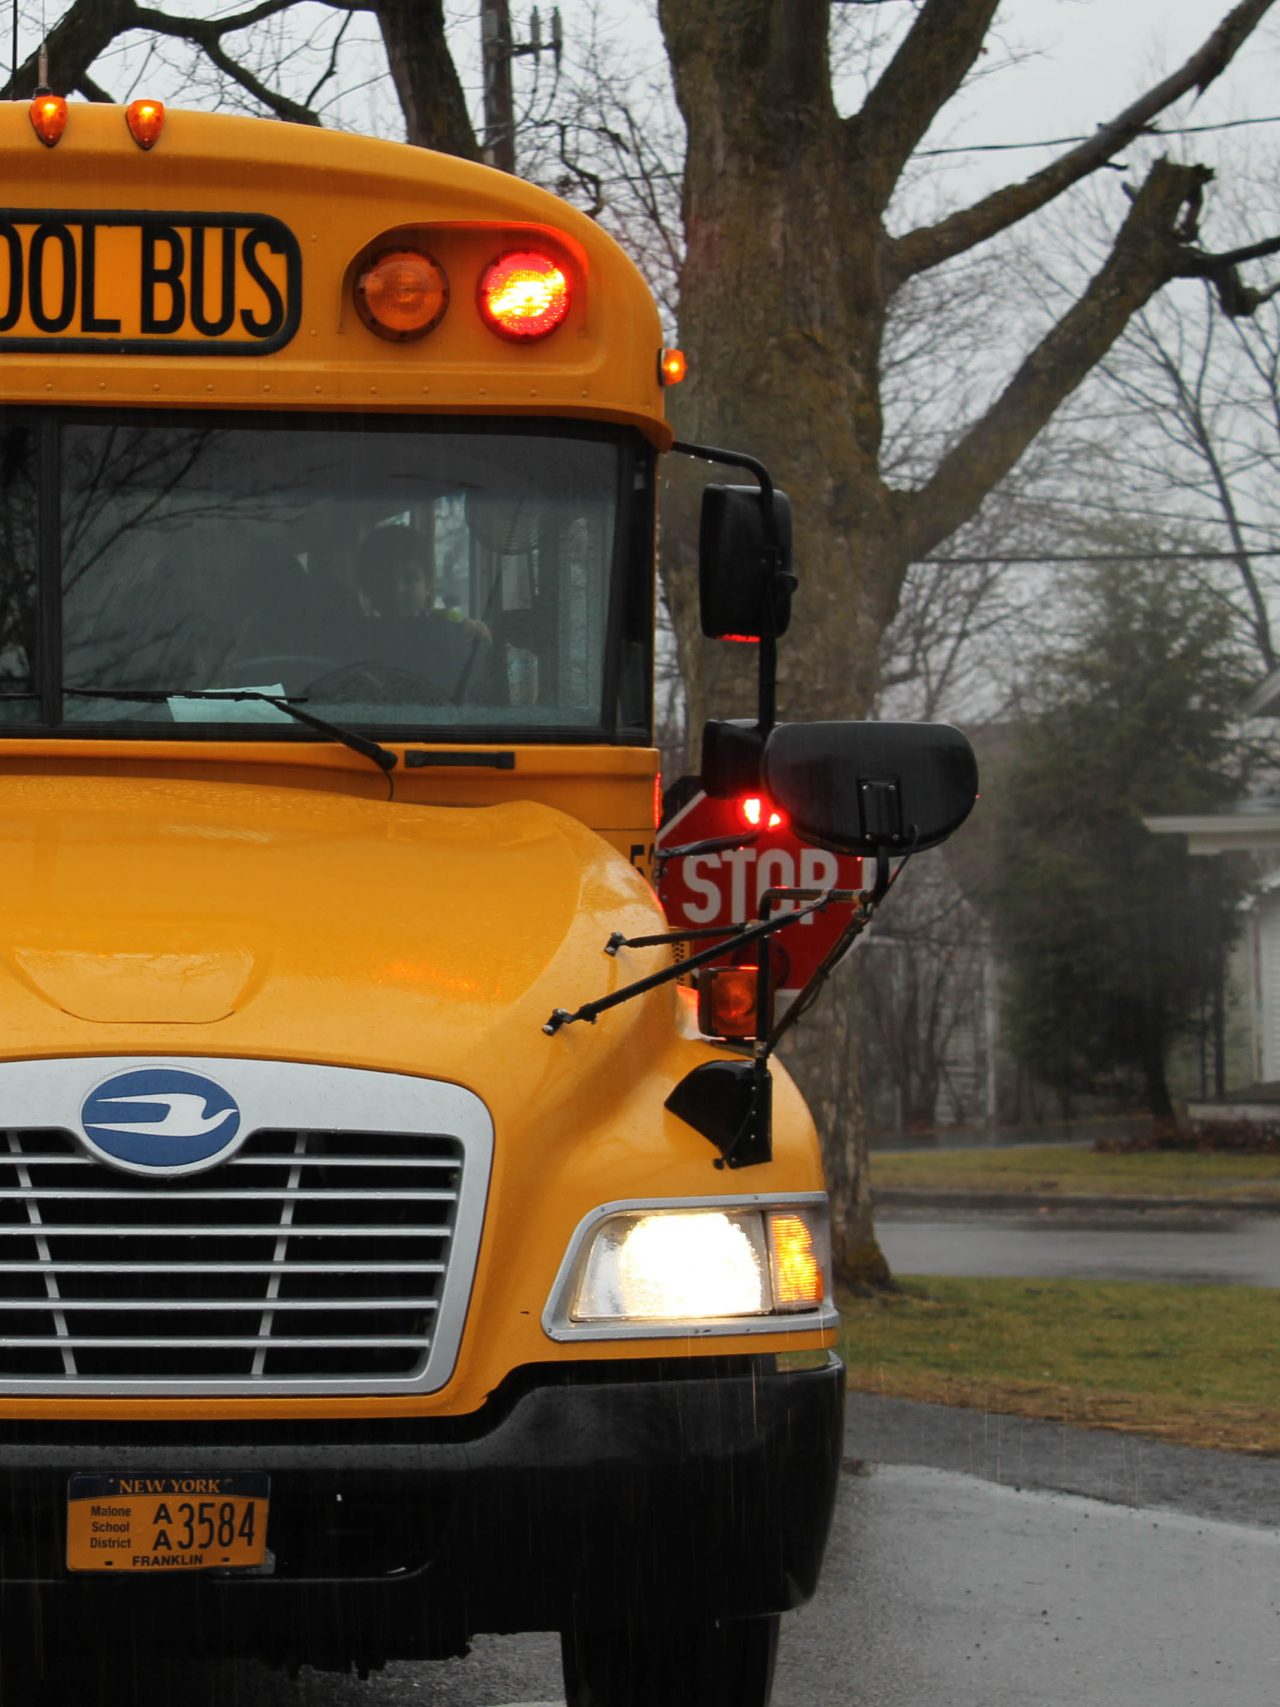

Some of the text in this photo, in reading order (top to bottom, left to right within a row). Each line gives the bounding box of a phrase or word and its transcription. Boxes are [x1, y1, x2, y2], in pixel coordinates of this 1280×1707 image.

[140, 225, 286, 338] BUS
[682, 847, 838, 925] STOP
[119, 1479, 221, 1494] NEW YORK
[90, 1505, 132, 1517] Malone
[152, 1503, 173, 1525] A
[91, 1521, 130, 1533] School
[177, 1502, 256, 1550] 3584
[90, 1537, 132, 1549] District
[152, 1529, 173, 1551] A
[132, 1554, 204, 1567] FRANKLIN
